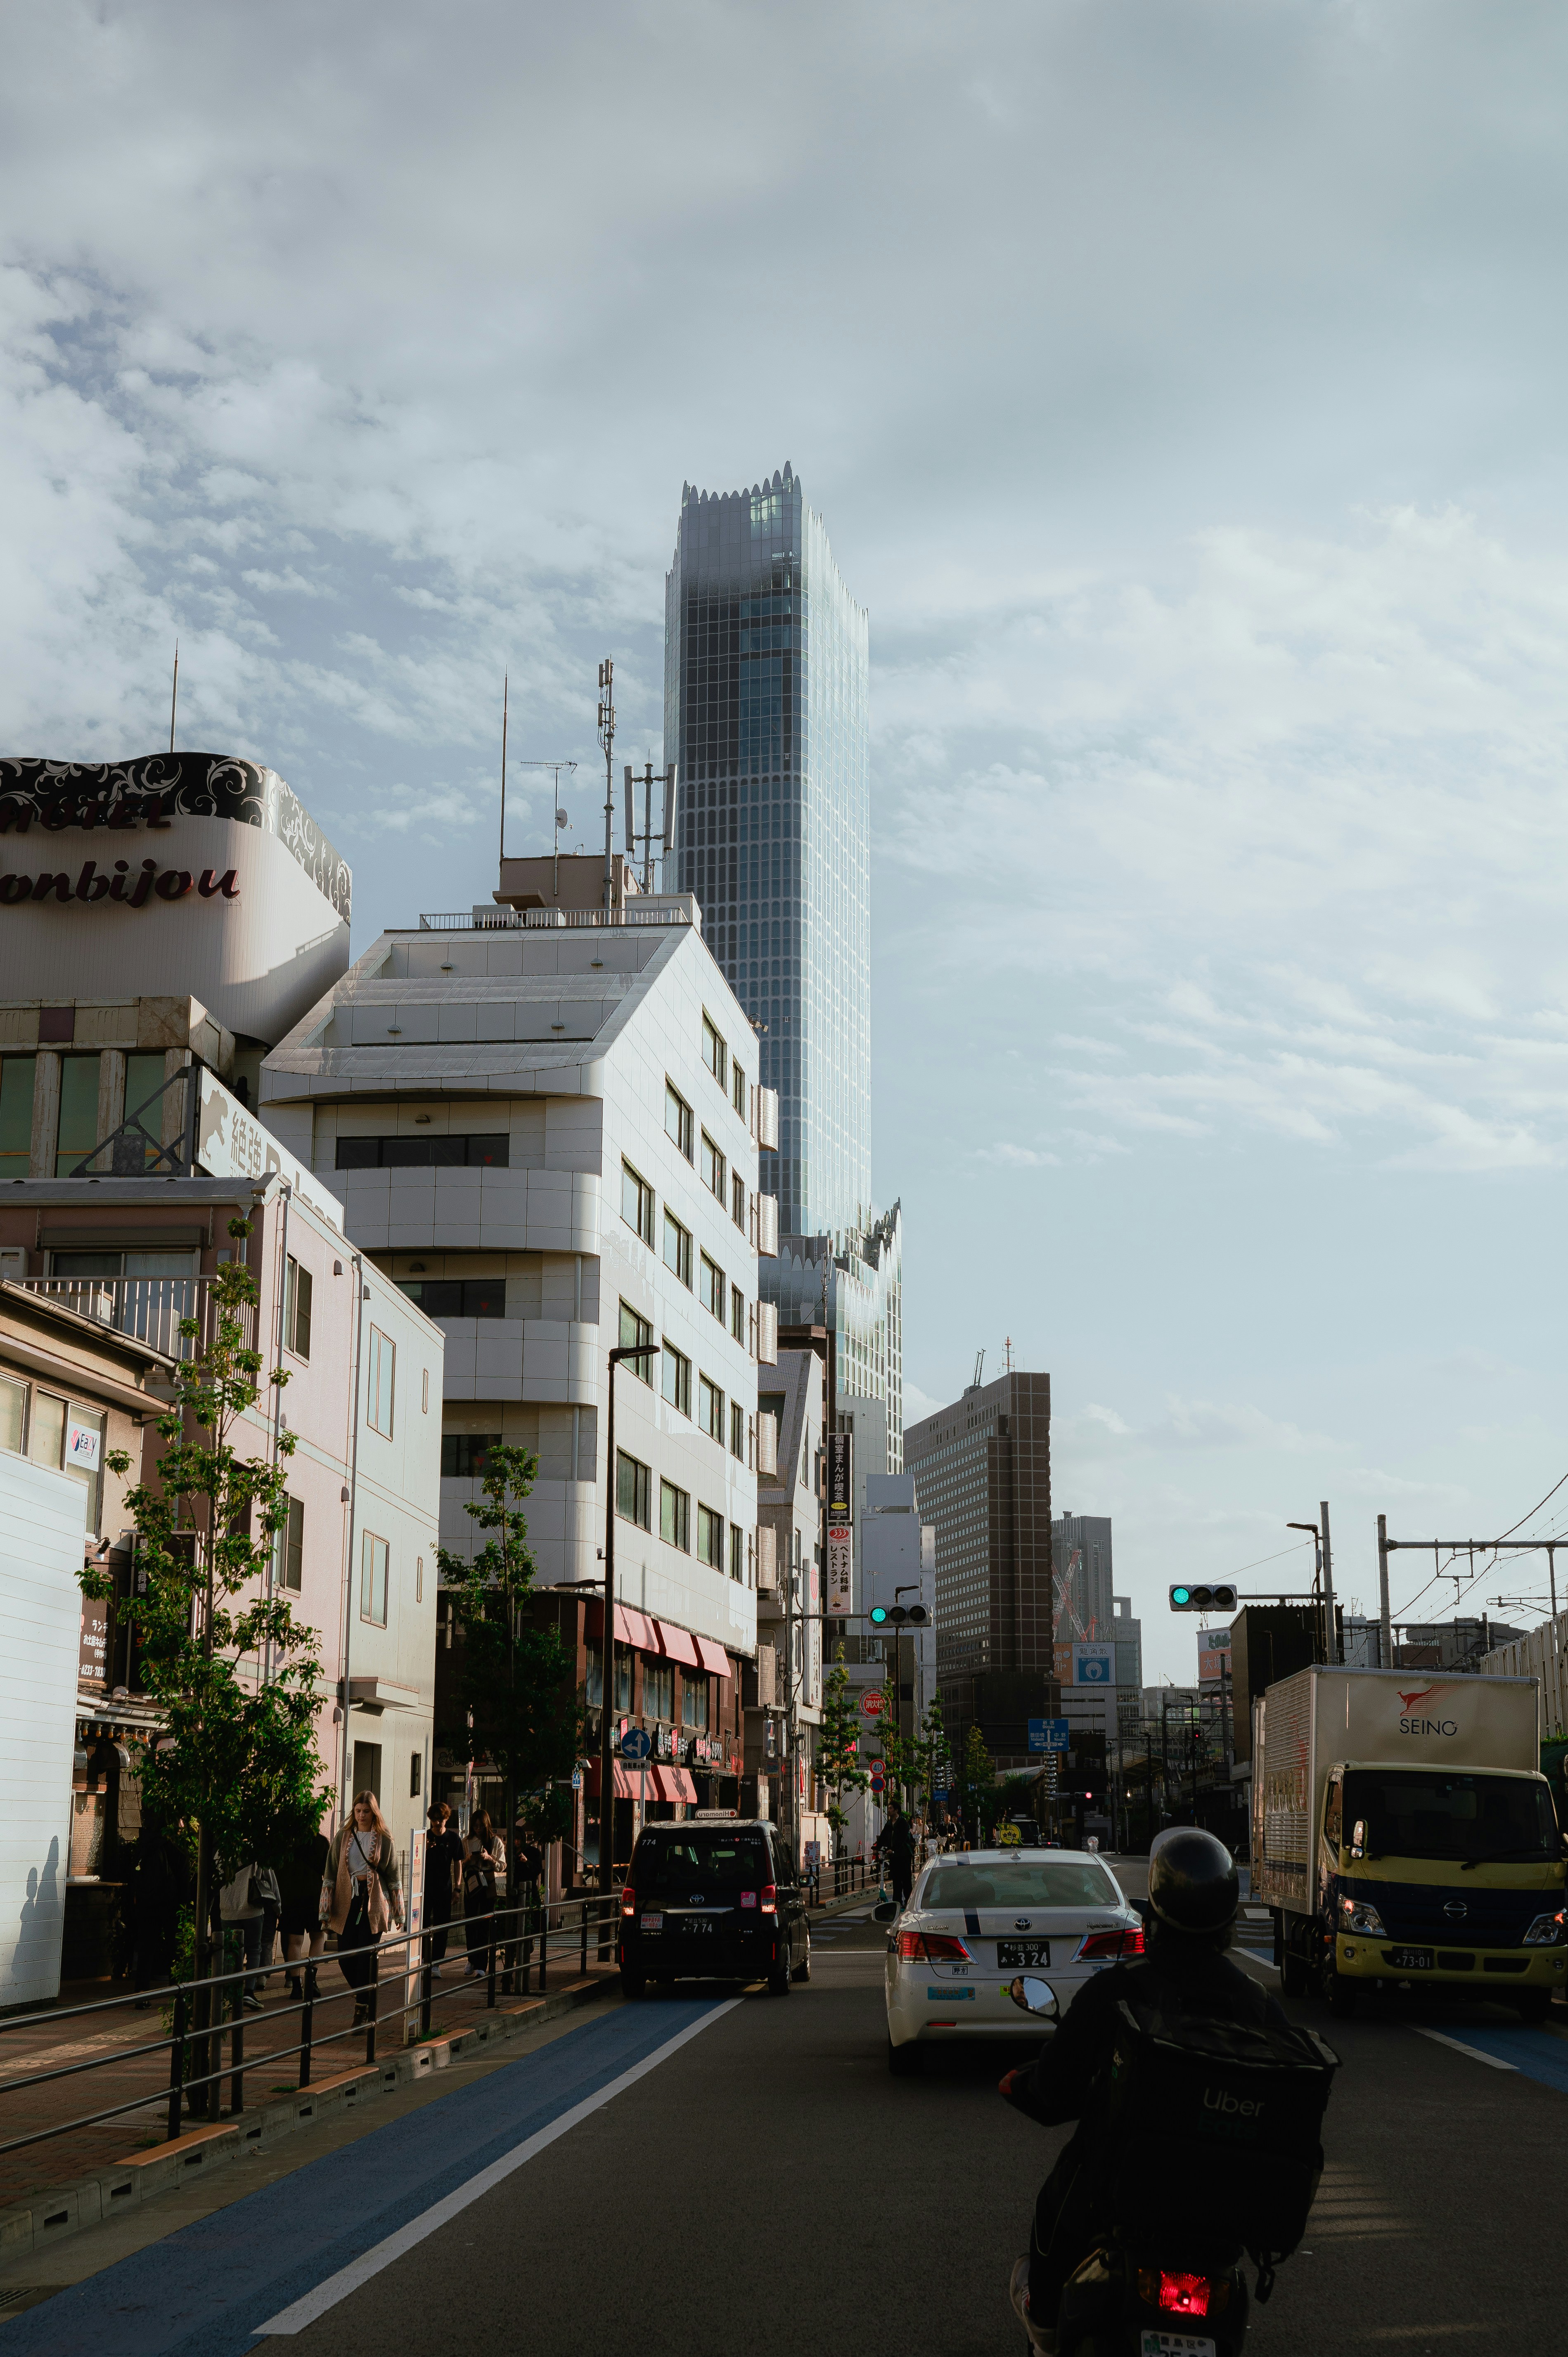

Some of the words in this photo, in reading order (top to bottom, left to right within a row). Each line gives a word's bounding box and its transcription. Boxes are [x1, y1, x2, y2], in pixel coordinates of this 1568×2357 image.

[0, 797, 172, 833] HOTEL
[834, 1435, 844, 1501] 個室まんが喫茶
[832, 1529, 846, 1537] 333
[830, 1545, 838, 1585] レストラン
[840, 1545, 849, 1593] ベトナム料理
[92, 1620, 108, 1633] ランチ
[78, 1663, 106, 1677] -6233-7830
[865, 1699, 883, 1709] 消火栓
[1399, 1718, 1457, 1736] SEINO
[1402, 1956, 1430, 1968] 73-01
[1203, 2087, 1266, 2118] Uber
[1196, 2110, 1260, 2140] Eats
